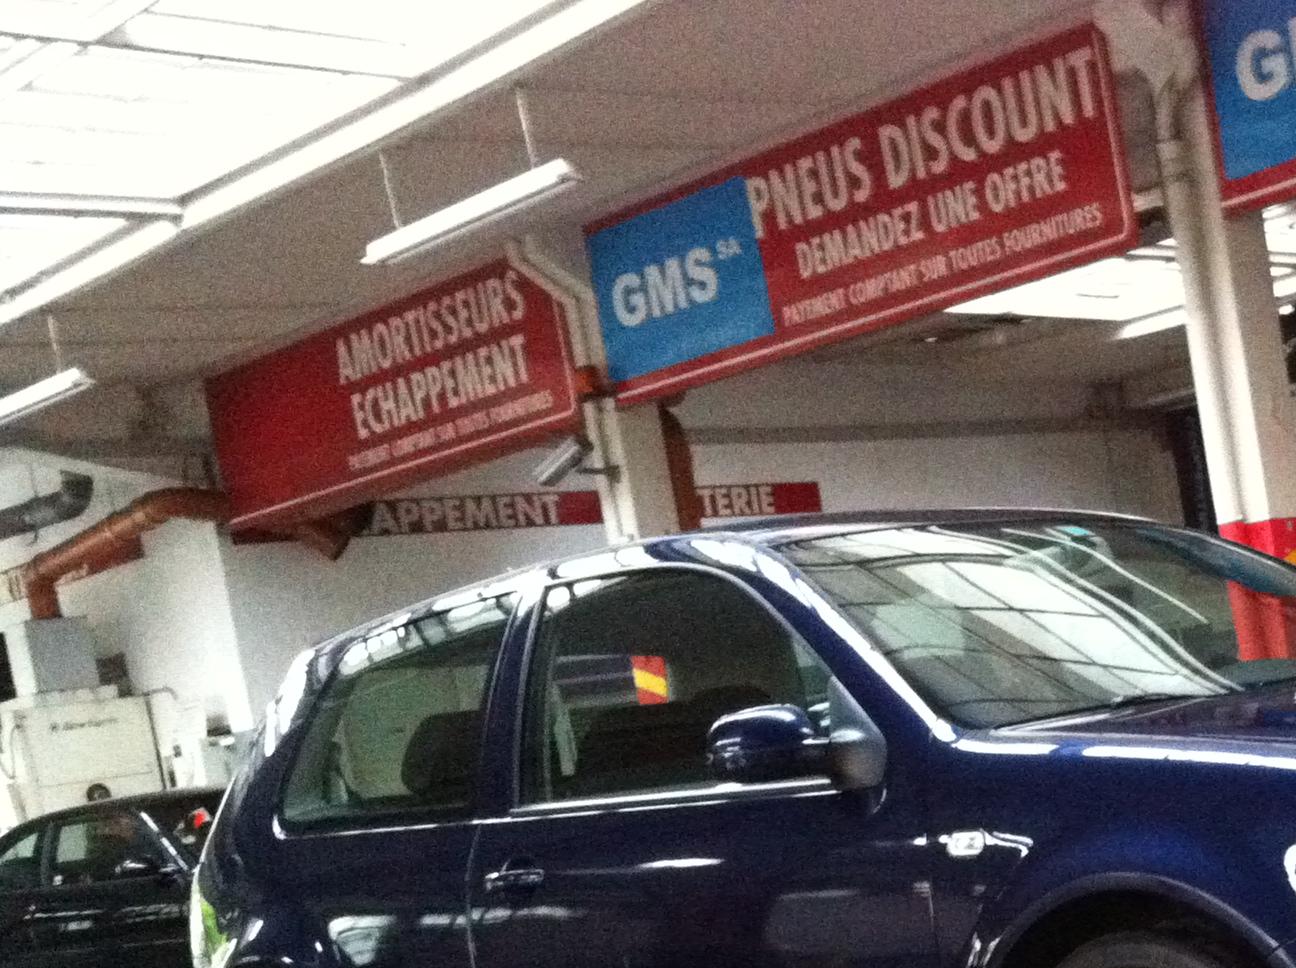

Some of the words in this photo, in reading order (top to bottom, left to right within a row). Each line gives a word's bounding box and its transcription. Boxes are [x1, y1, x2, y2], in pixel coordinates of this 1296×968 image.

[746, 136, 872, 238] PNEUS
[878, 46, 1096, 192] DISCOUNT
[795, 201, 924, 280] DEMANDEZ
[927, 179, 980, 234] UNE
[984, 150, 1067, 214] OFFRE
[335, 270, 525, 386] AMORTISSEURS
[611, 247, 719, 328] GMS
[350, 333, 529, 441] ECHAPPEMENT
